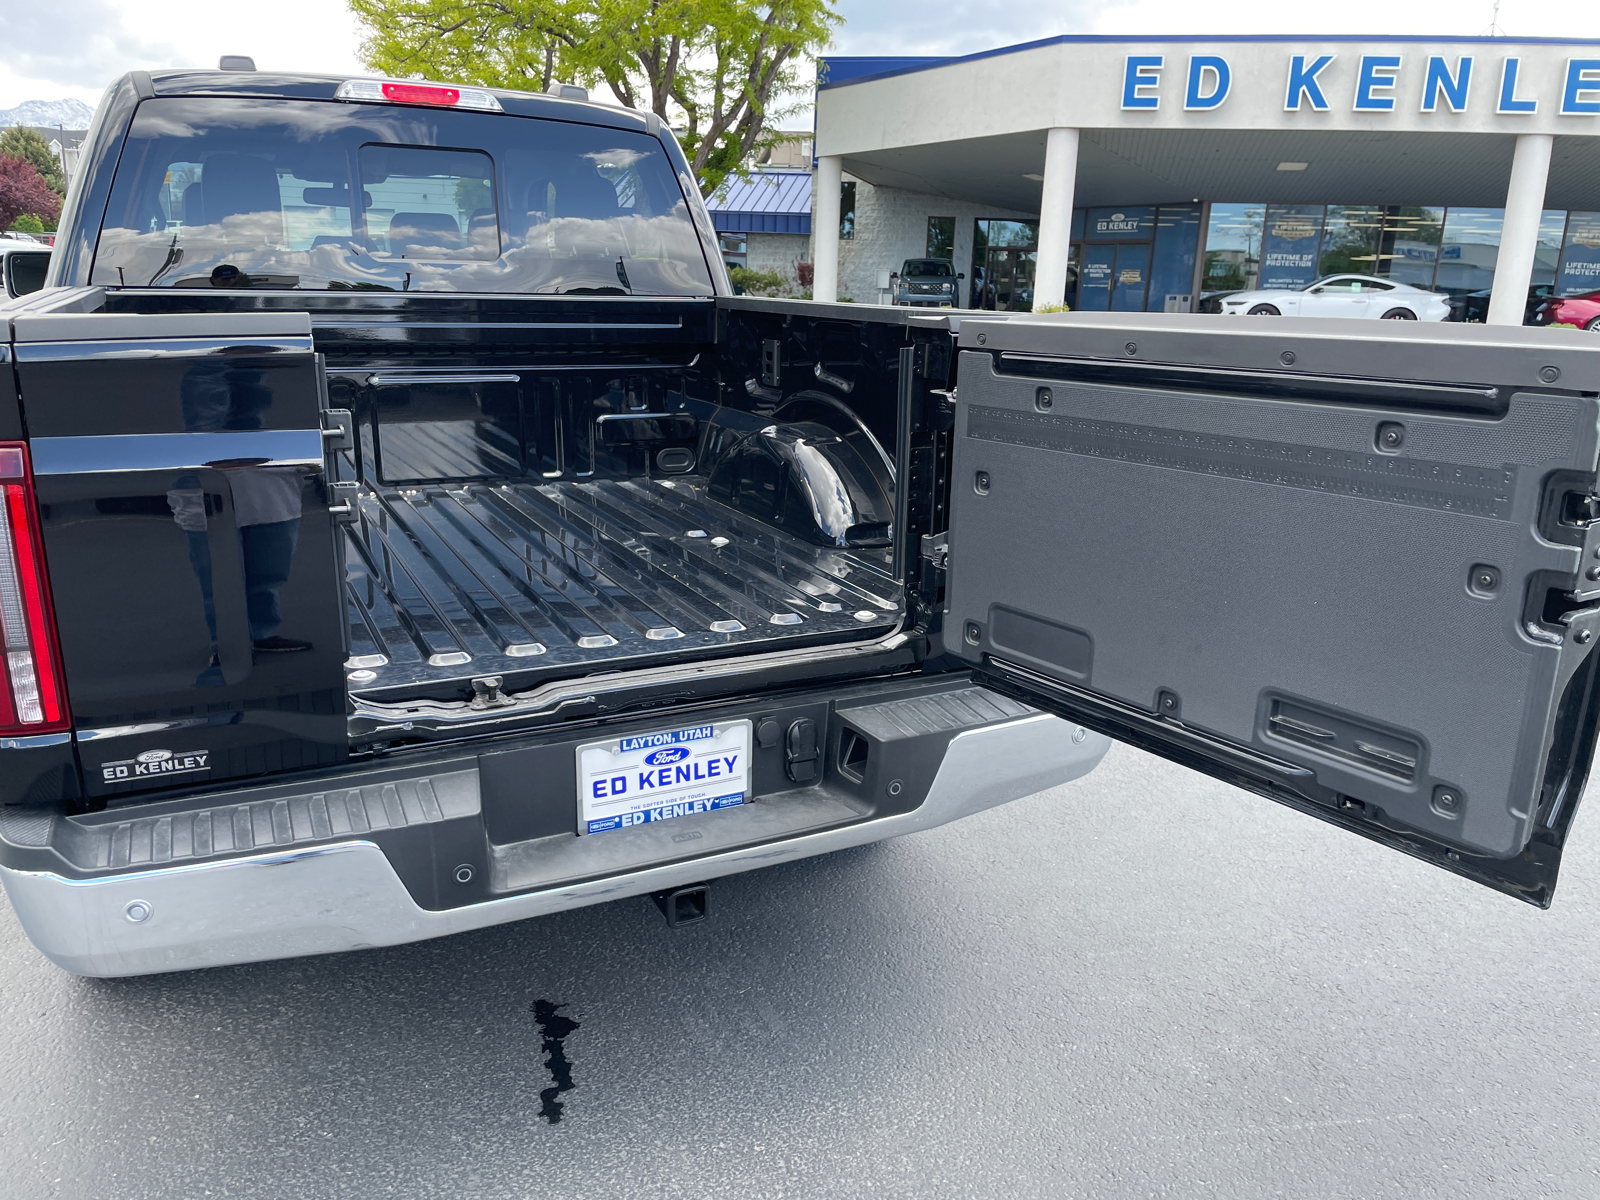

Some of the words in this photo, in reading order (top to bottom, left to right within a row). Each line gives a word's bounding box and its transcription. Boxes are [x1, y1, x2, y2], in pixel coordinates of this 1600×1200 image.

[1120, 54, 1232, 111] ED
[1097, 222, 1107, 230] ED
[1109, 221, 1138, 230] KENLEY
[1266, 260, 1312, 268] PROTECTION
[622, 733, 676, 752] LAYTON,
[679, 726, 711, 741] UTAH
[144, 752, 165, 761] Ford
[652, 750, 682, 765] Ford
[103, 766, 128, 779] ED
[135, 755, 207, 775] KENLEY
[592, 775, 627, 799] ED
[639, 755, 738, 791] KENLEY
[642, 801, 664, 809] SOFTER
[687, 792, 707, 800] TOUGH.
[621, 812, 645, 827] ED
[650, 799, 714, 822] KENLEY
